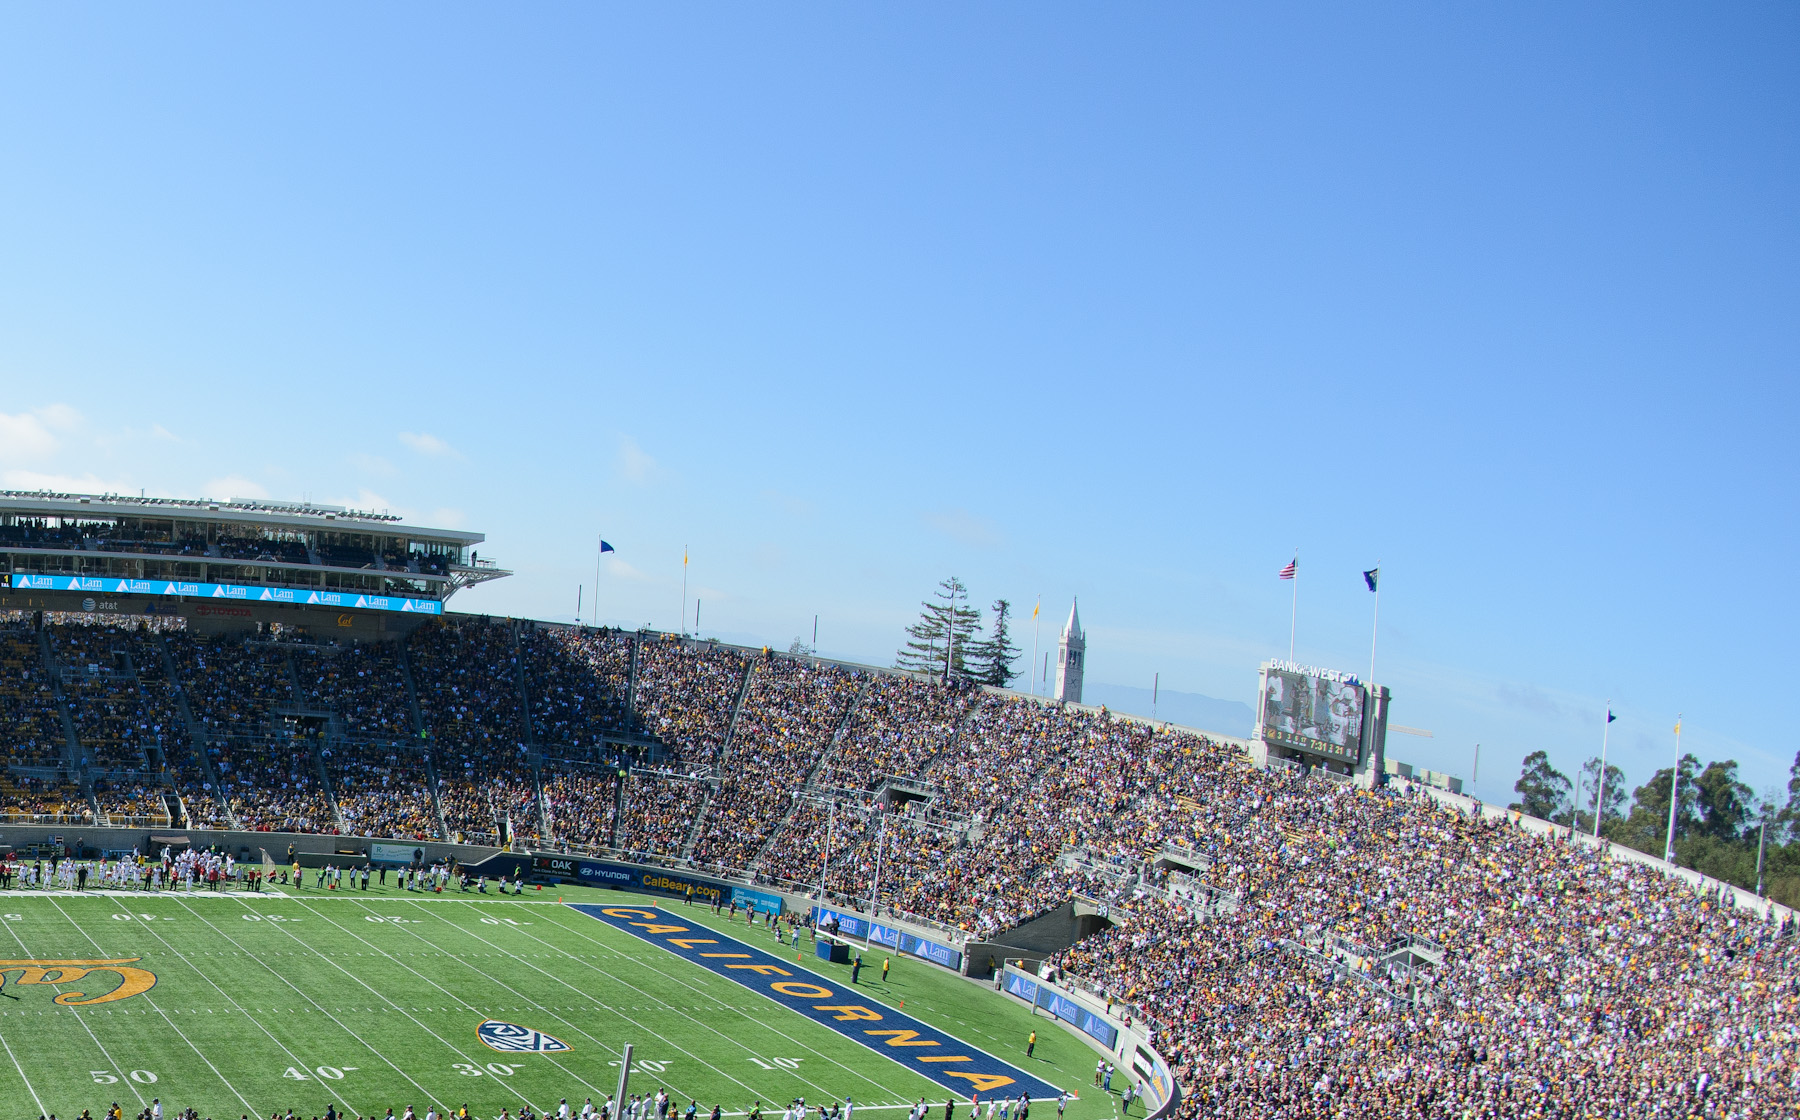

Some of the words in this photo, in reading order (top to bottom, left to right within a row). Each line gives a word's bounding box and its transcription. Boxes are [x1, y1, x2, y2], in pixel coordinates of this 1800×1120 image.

[32, 575, 53, 585] Lam
[82, 578, 102, 588] Lam
[130, 579, 150, 589] Lam
[178, 582, 198, 592] Lam
[226, 585, 246, 595] Lam
[274, 588, 293, 598] Lam
[321, 592, 341, 602] Lam
[368, 595, 388, 605] Lam
[415, 599, 434, 610] Lam
[99, 602, 118, 610] at&t
[212, 607, 252, 618] TOYOTA
[1270, 658, 1301, 673] BANK
[1310, 665, 1342, 682] WEST
[1310, 740, 1326, 751] 7:31
[551, 860, 572, 871] OAK
[595, 869, 630, 881] HYUNDAI
[643, 874, 721, 897] CalBearcom
[930, 944, 948, 961] Lam
[602, 907, 1016, 1093] CALIFORNIA
[1060, 1000, 1076, 1018] Lam
[746, 1056, 799, 1070] 10
[283, 1065, 345, 1081] 40
[452, 1061, 515, 1077] 30
[89, 1069, 158, 1085] 50
